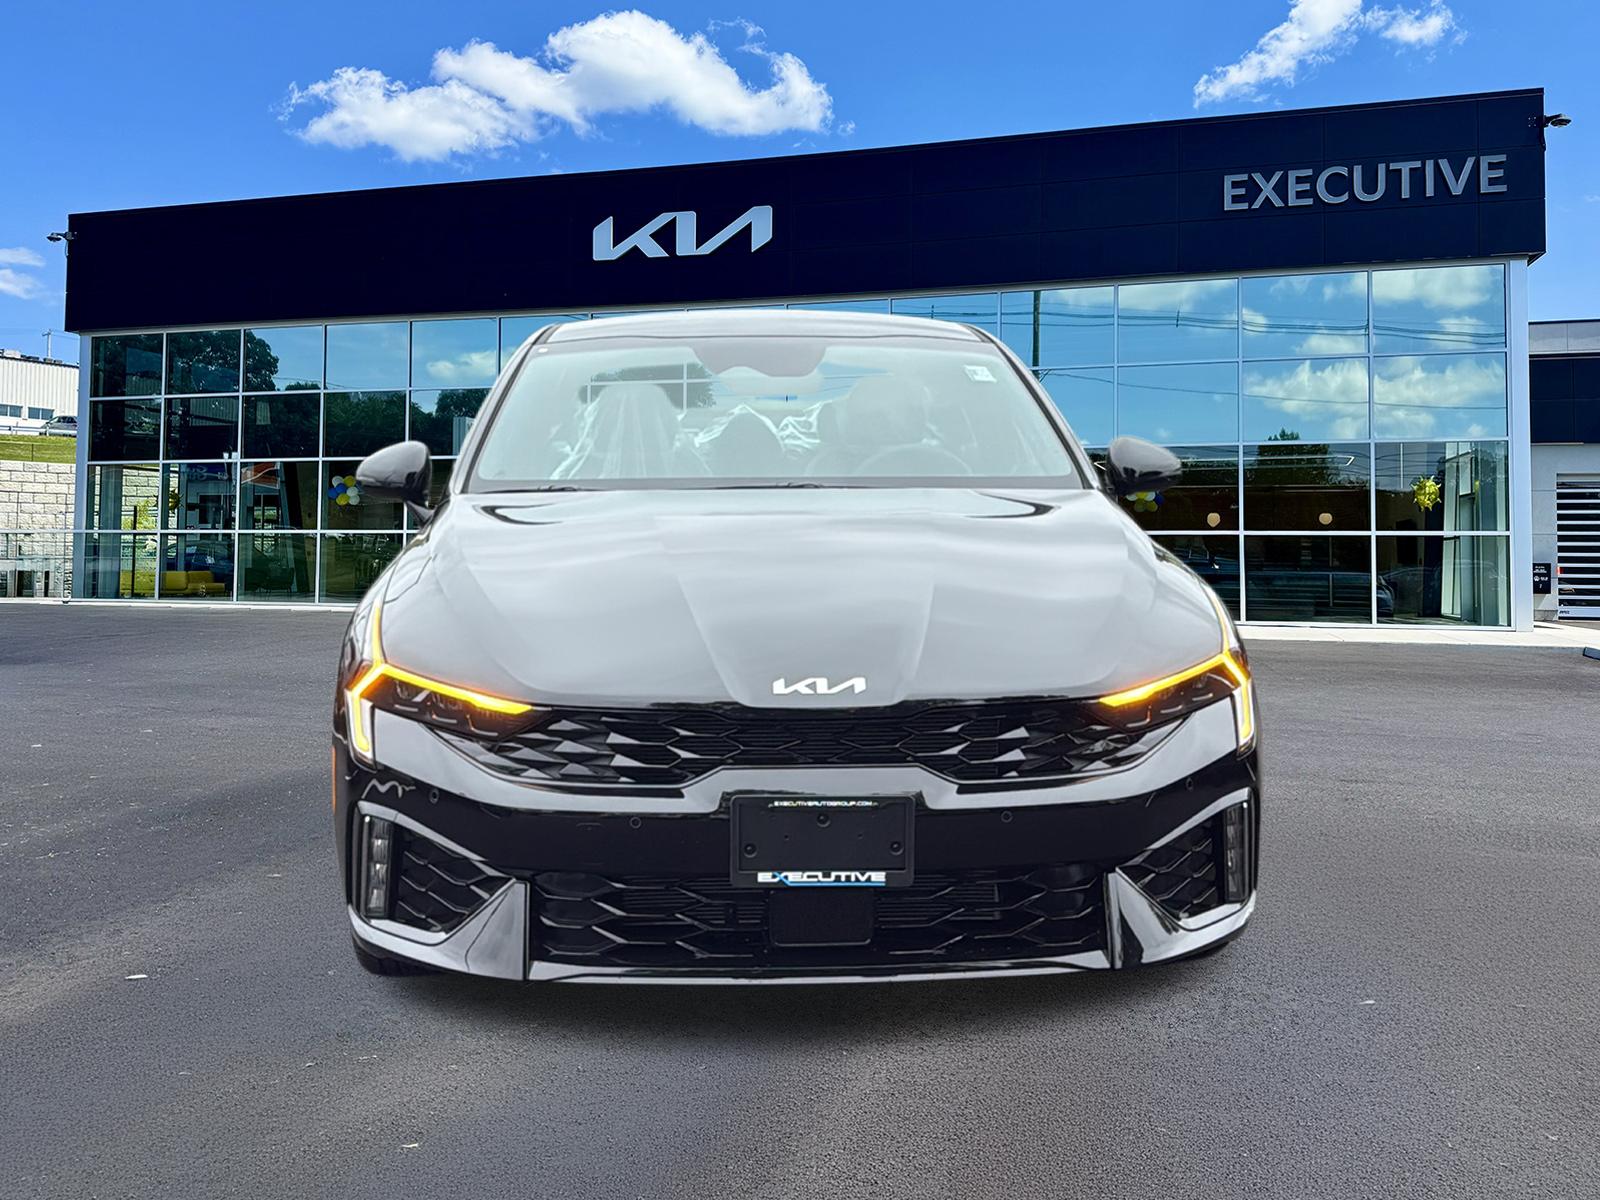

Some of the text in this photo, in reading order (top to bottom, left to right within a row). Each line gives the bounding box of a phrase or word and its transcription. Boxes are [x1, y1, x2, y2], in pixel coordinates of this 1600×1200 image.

[1223, 154, 1507, 211] EXECUTIVE
[593, 205, 773, 261] KIA
[772, 677, 867, 695] KIA
[757, 871, 887, 886] EXECUTIVE
